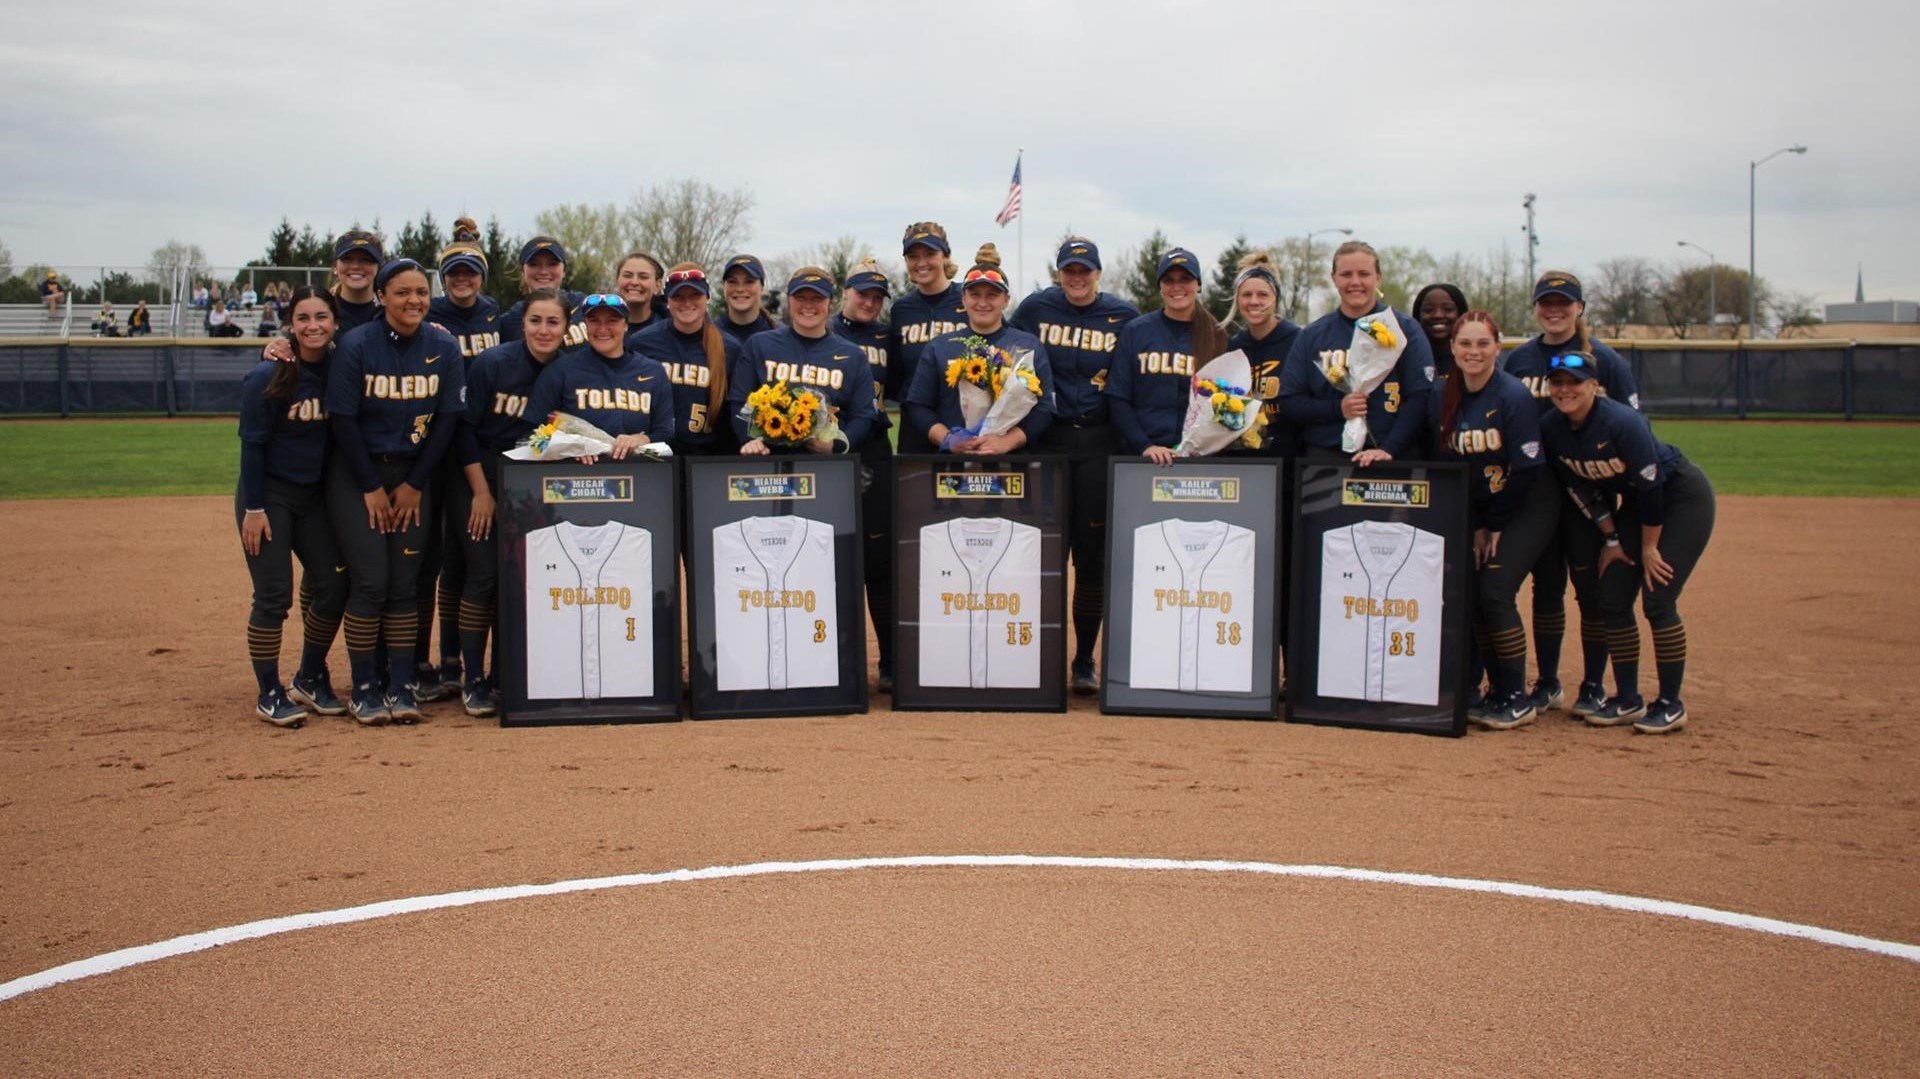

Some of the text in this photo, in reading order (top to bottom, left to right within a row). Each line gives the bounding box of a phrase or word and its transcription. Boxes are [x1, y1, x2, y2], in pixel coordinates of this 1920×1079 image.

[458, 331, 500, 357] LEDO
[1038, 323, 1117, 353] TOLEDO
[765, 360, 844, 390] TOLEDO
[1138, 351, 1195, 376] TOLE
[365, 374, 440, 400] TOLEDO
[287, 397, 330, 421] TOL
[575, 388, 652, 414] TOLEDO
[572, 479, 605, 488] MEGAN
[618, 480, 626, 498] 1
[759, 485, 784, 494] WEBB
[800, 477, 809, 495] 3
[967, 475, 993, 484] KATIE
[969, 484, 992, 492] COZY
[1006, 476, 1021, 494] 15
[1221, 481, 1235, 499] 18
[571, 488, 606, 497] CHOATE
[1364, 490, 1408, 501] BERGMAN
[1411, 485, 1427, 503] 31
[550, 586, 632, 610] TOLEDO
[739, 589, 817, 613] TOLEDO
[941, 592, 1021, 616] TOLEDO
[1154, 588, 1233, 614] TOLEDO
[1343, 596, 1420, 623] TOLEDO
[625, 617, 637, 642] 1
[813, 620, 827, 643] 3
[1007, 622, 1033, 646] 15
[1216, 621, 1242, 646] 18
[1389, 631, 1416, 656] 31
